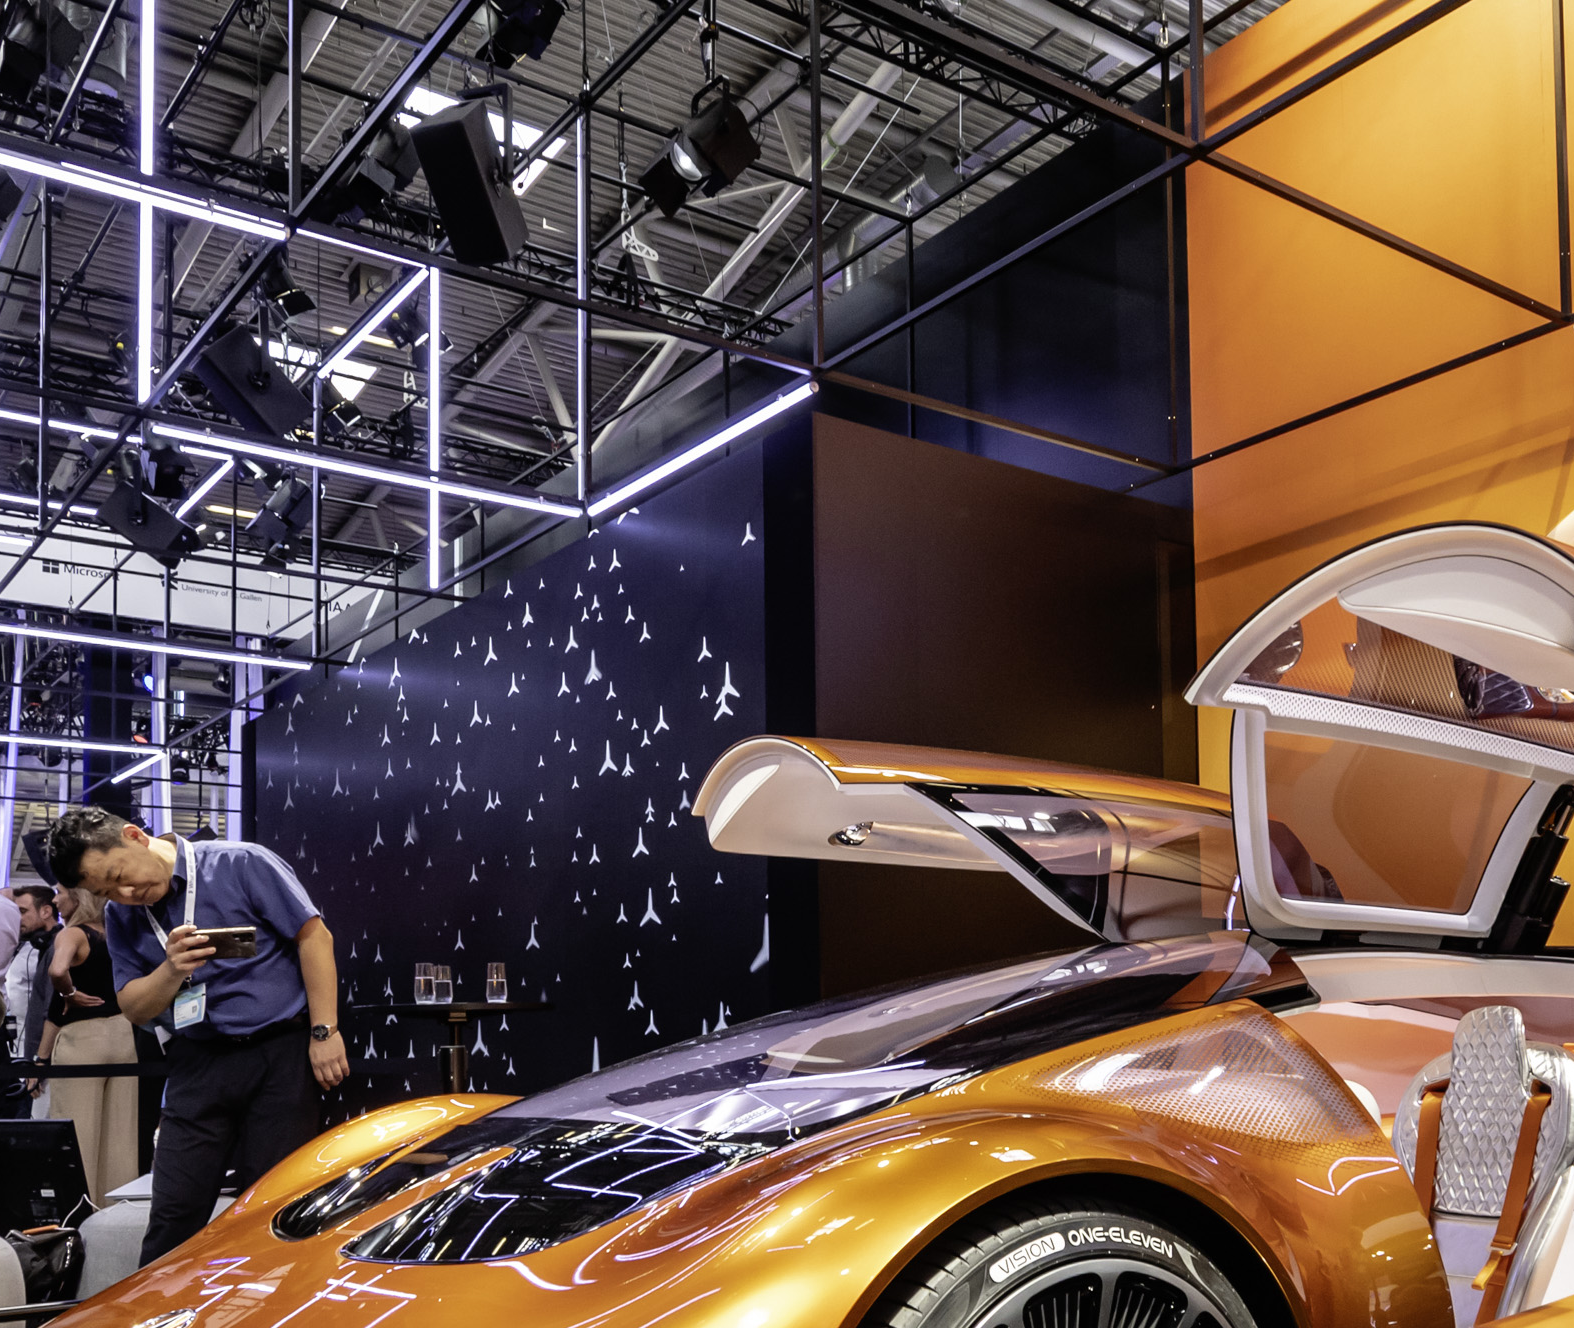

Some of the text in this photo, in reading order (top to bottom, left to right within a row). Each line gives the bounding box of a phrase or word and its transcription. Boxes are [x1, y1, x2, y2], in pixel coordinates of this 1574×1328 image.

[181, 584, 219, 597] University
[240, 592, 262, 602] Gallen
[998, 1226, 1173, 1275] VISION ONE-ELEVEN
